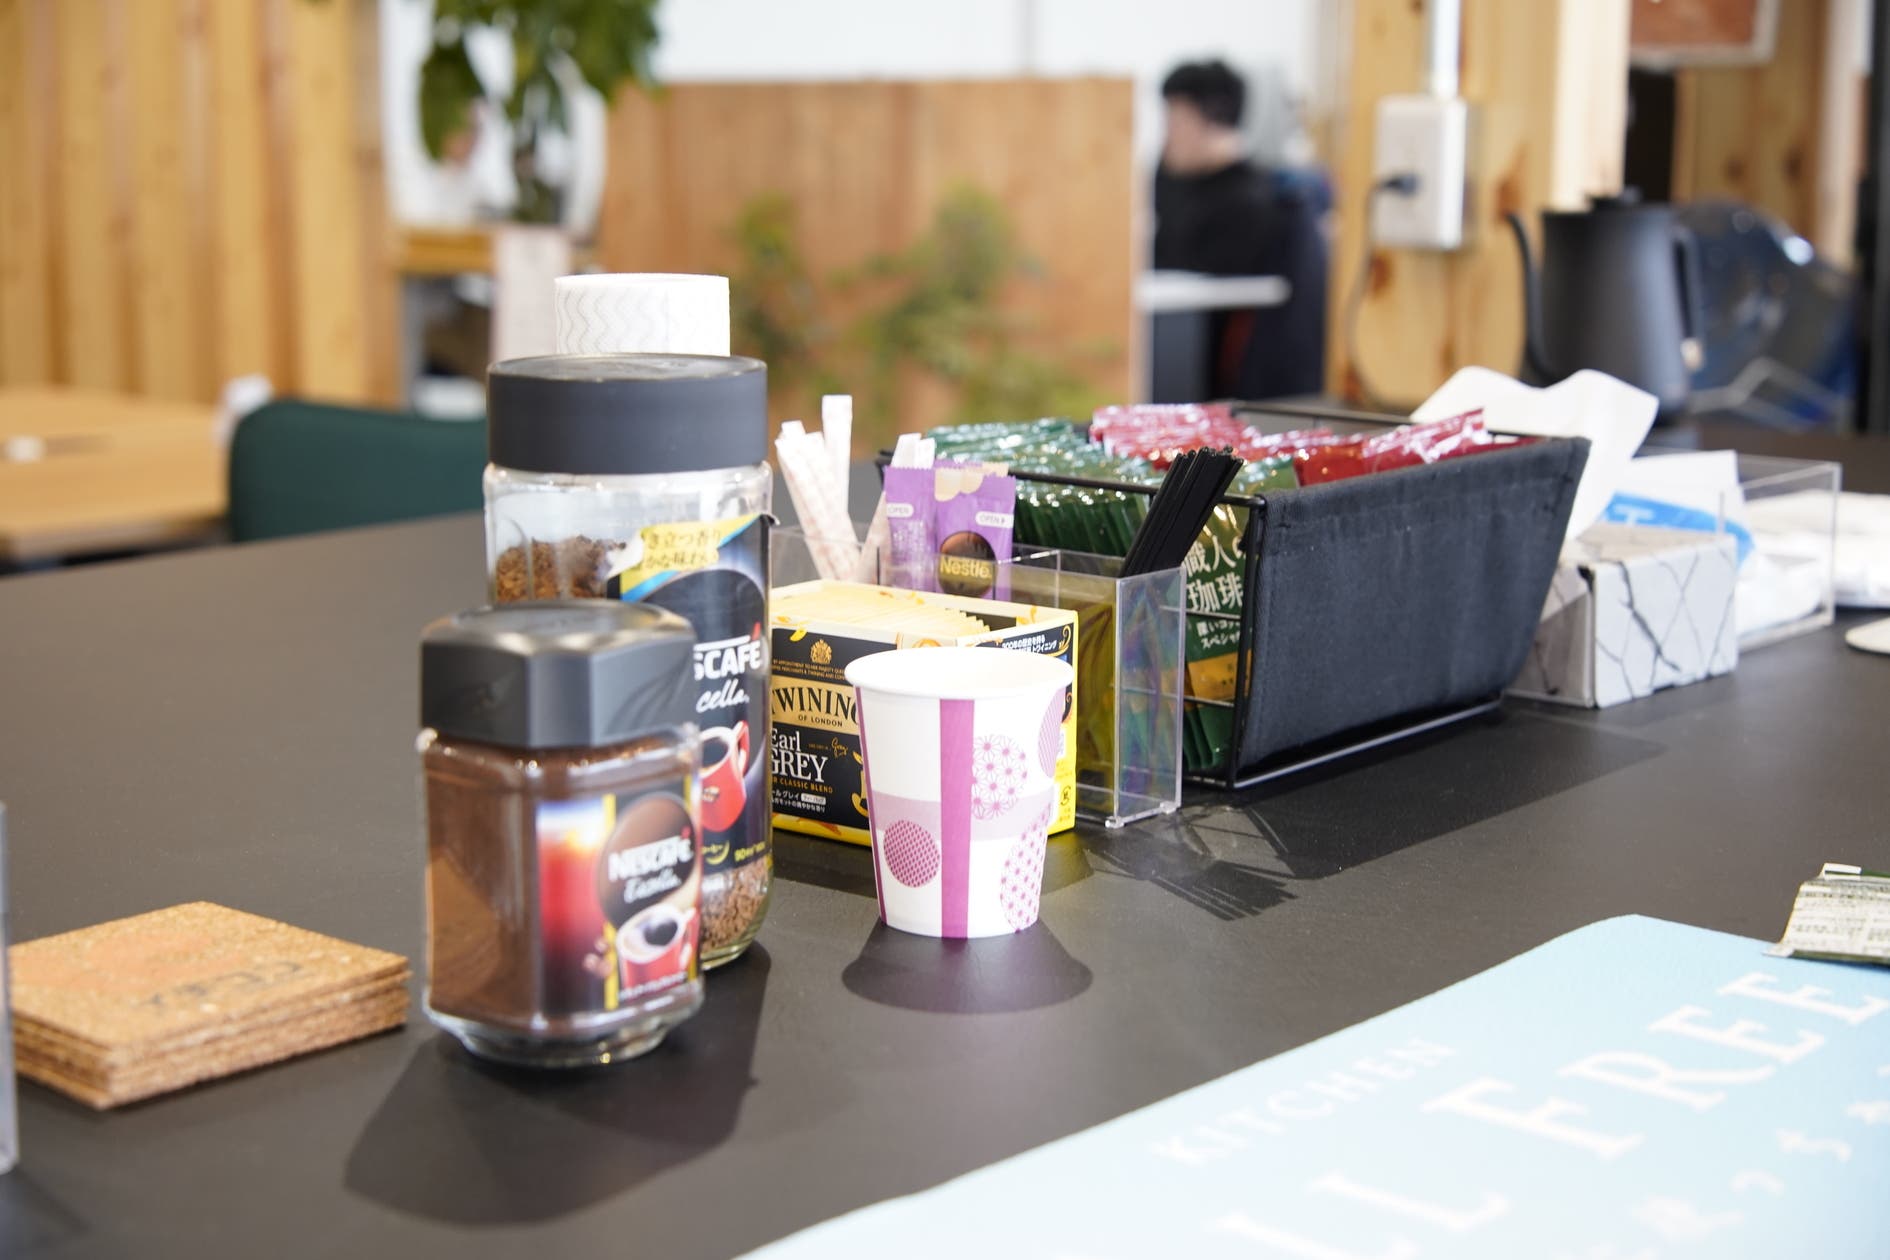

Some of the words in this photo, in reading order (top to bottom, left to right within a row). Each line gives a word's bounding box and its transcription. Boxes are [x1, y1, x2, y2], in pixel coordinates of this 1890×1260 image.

[1187, 571, 1244, 613] 珈琲
[811, 716, 843, 727] LONDON
[780, 778, 809, 789] CLASSIC
[810, 784, 833, 794] BLEND
[1420, 970, 1889, 1160] FREE
[1147, 1036, 1456, 1167] KITCHEN
